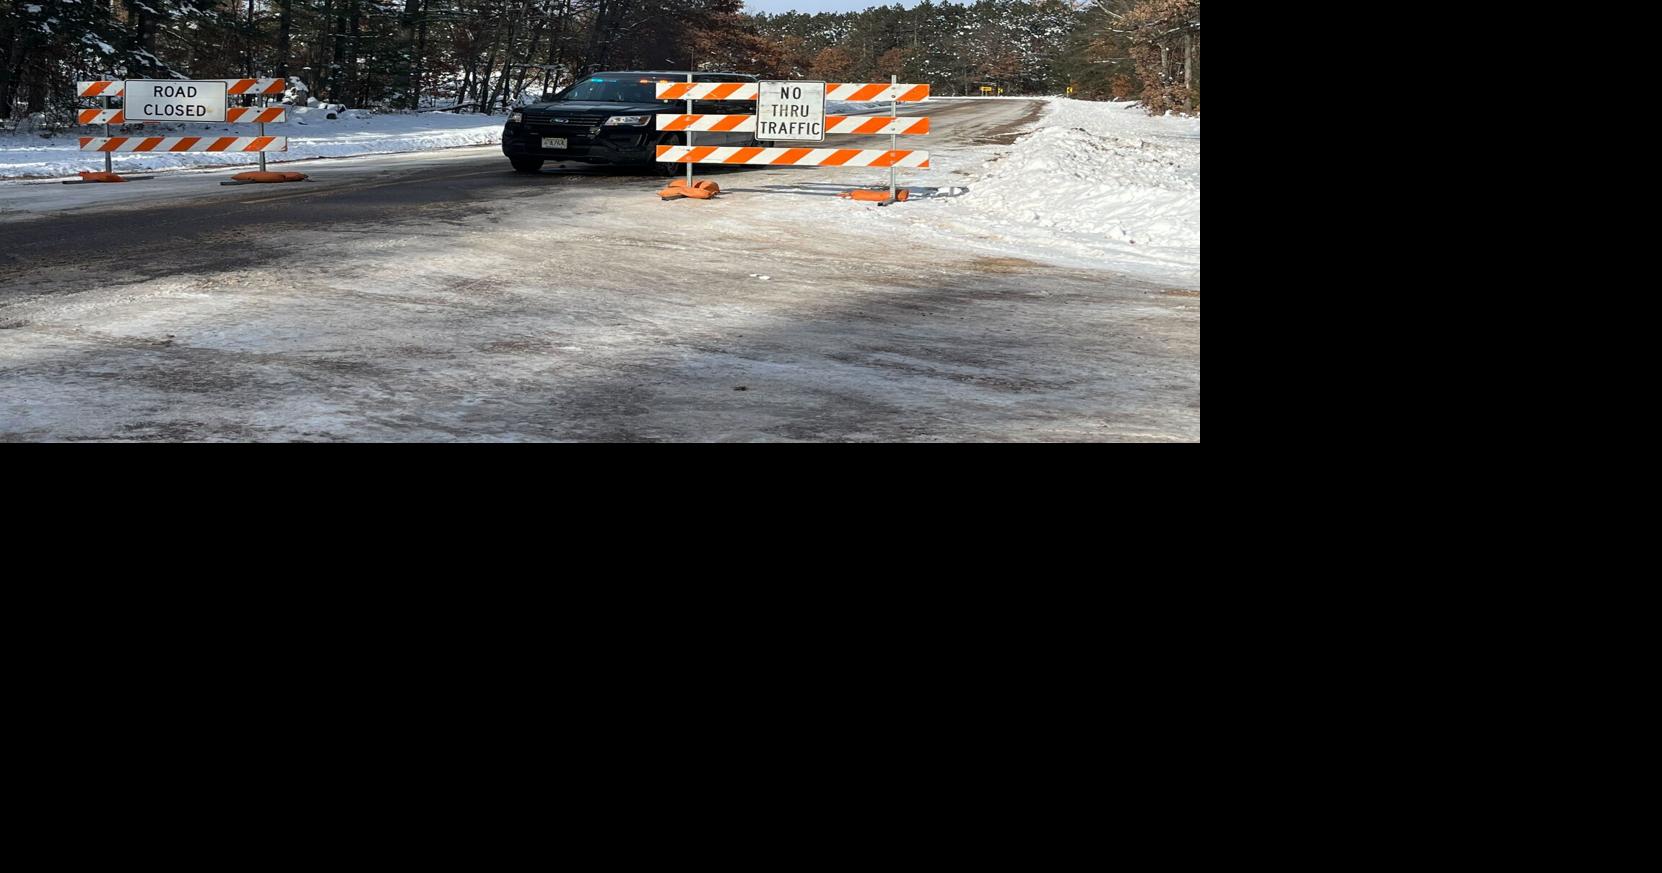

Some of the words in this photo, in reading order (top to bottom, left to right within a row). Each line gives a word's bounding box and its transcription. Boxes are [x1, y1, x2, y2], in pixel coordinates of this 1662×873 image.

[153, 85, 197, 98] ROAD
[780, 86, 802, 100] NO
[143, 103, 206, 116] CLOSED
[771, 104, 809, 117] THRU
[760, 121, 820, 135] TRAFFIC
